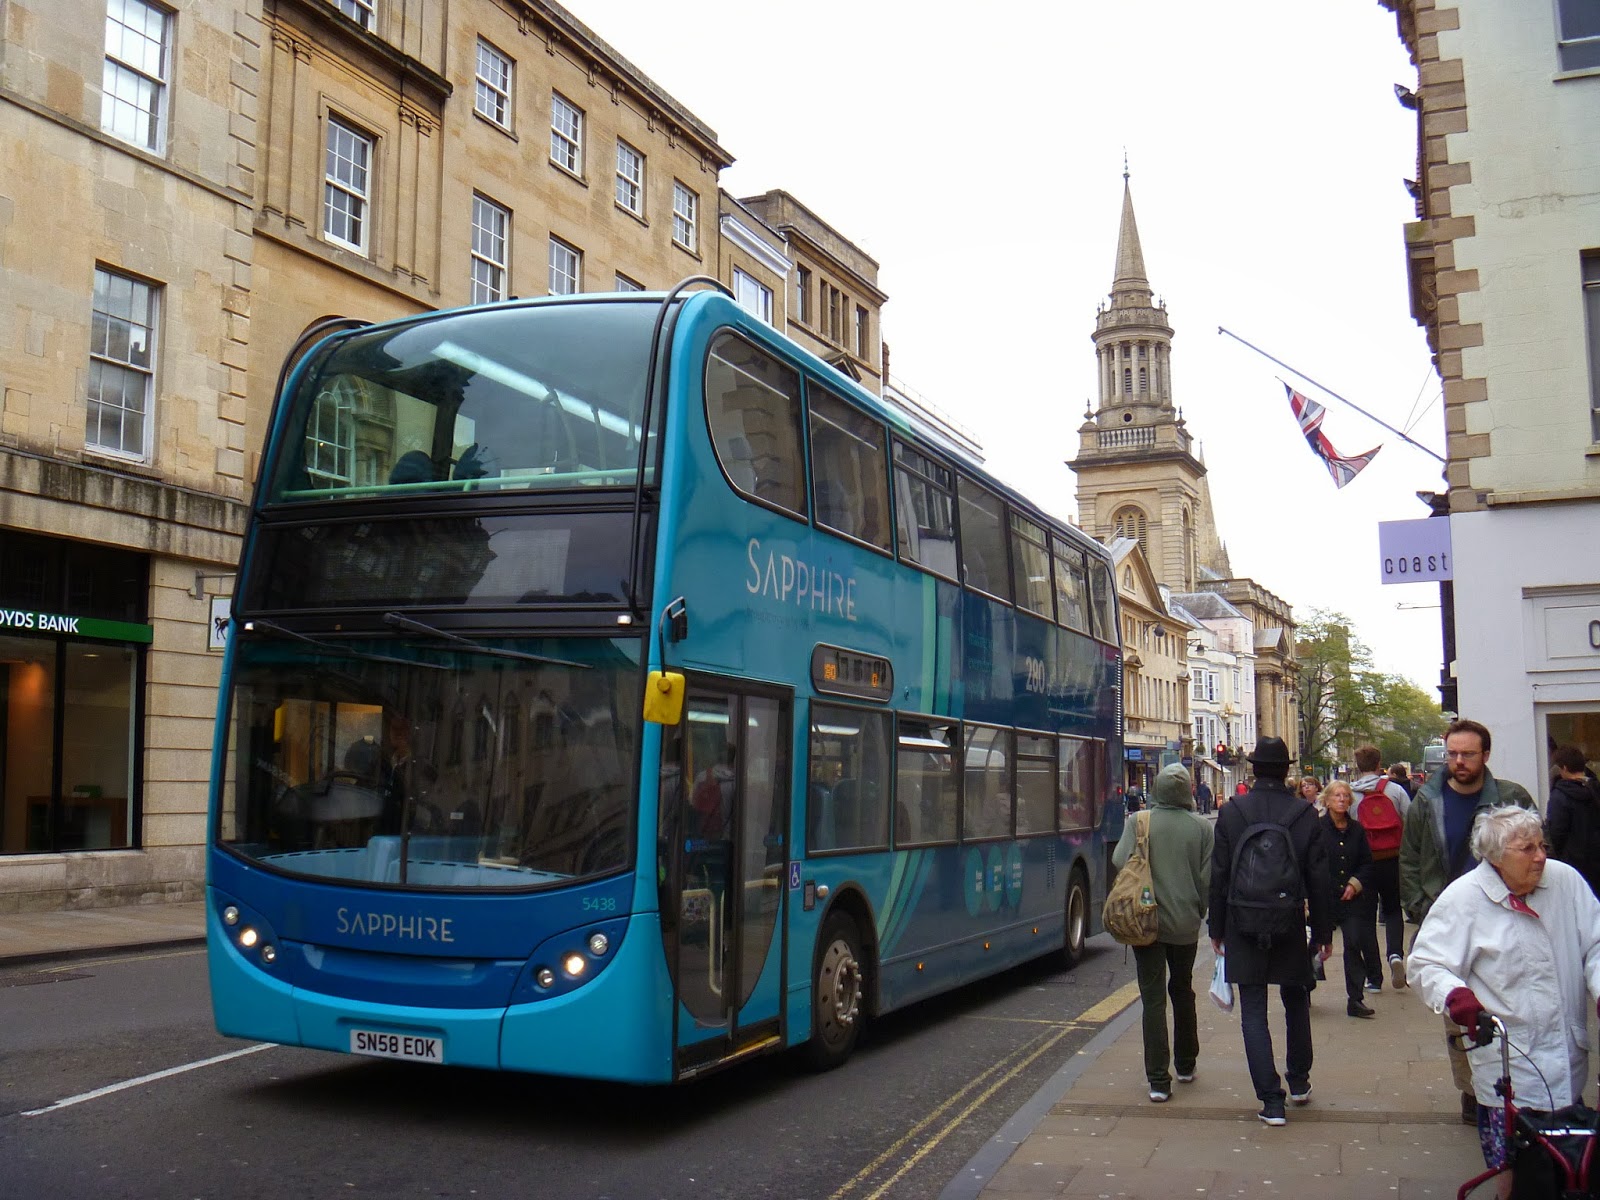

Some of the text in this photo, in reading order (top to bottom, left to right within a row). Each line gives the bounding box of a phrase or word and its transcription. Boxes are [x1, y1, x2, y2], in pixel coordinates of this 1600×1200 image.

[1384, 552, 1448, 574] coast
[746, 537, 857, 621] SAPPHIRE
[38, 614, 79, 633] BANK
[1025, 655, 1045, 694] 280
[582, 897, 616, 911] 5438
[336, 907, 455, 942] SAPPHIRE
[357, 1032, 436, 1057] SN58 EOK
